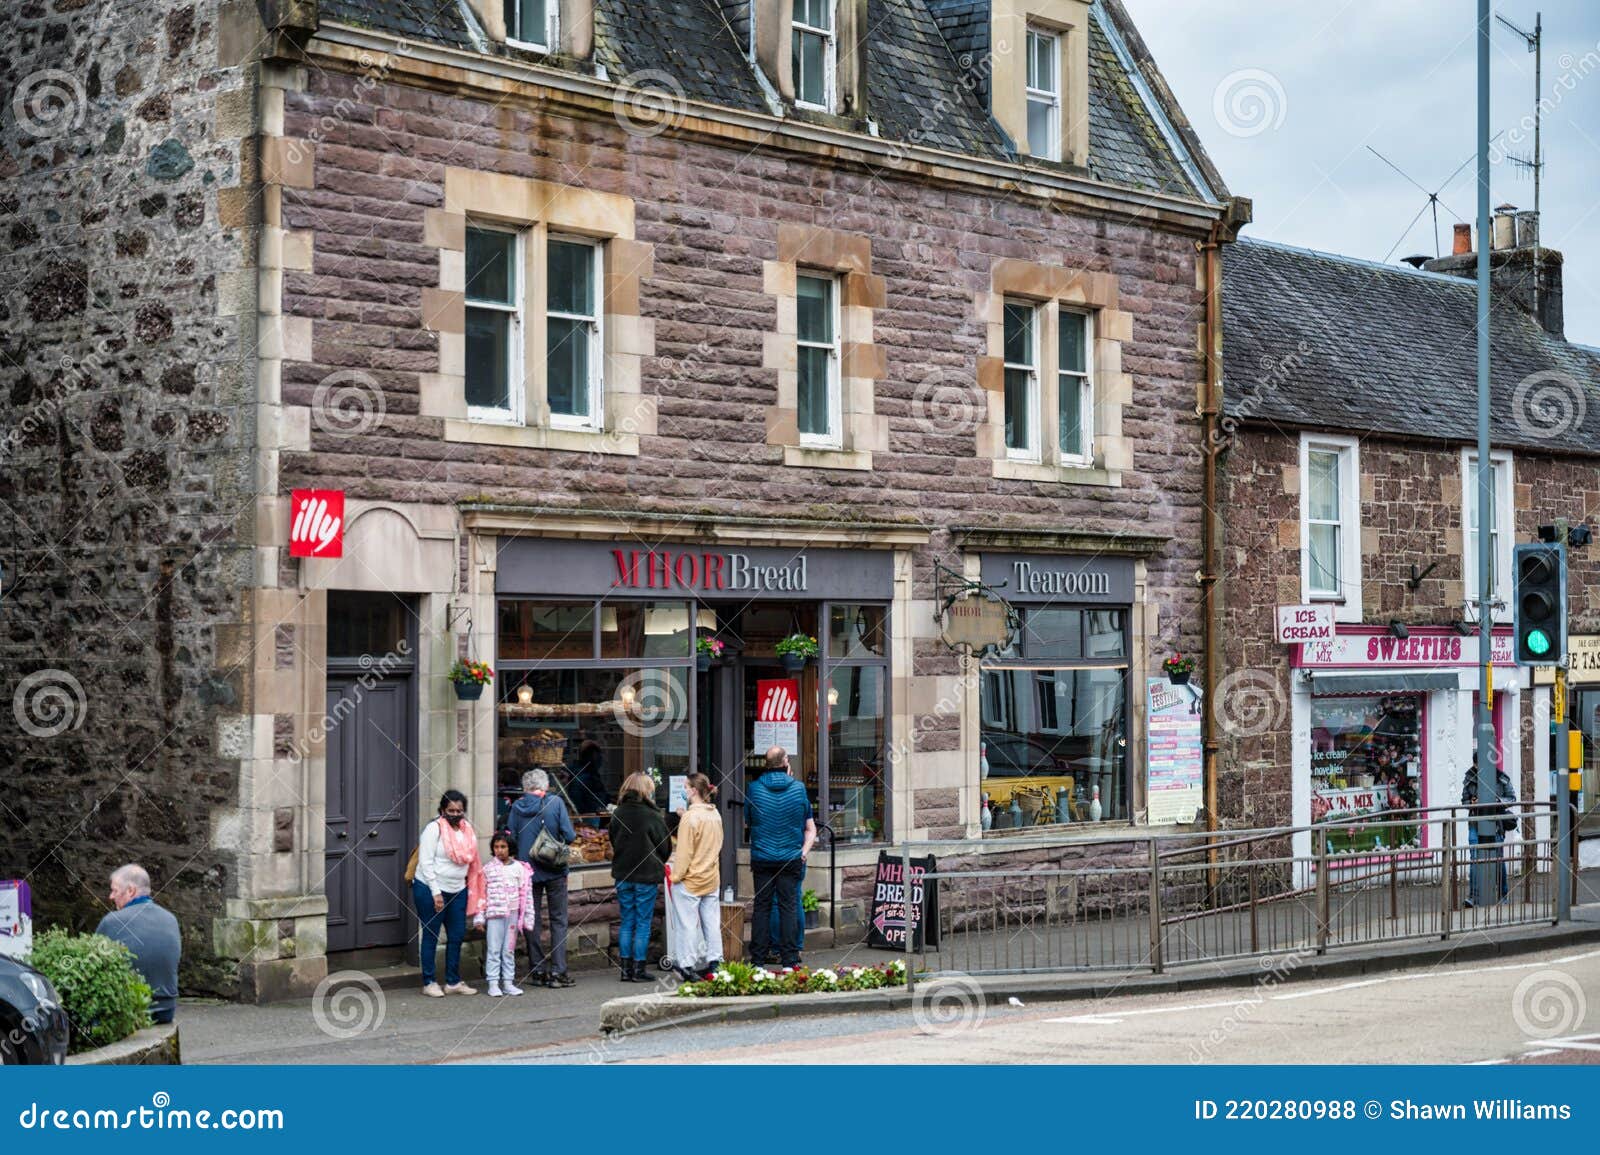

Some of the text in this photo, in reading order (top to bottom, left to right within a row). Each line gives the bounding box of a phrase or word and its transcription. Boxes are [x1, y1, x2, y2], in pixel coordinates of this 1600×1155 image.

[292, 497, 341, 552] illy
[1014, 561, 1110, 594] Tearoom
[1295, 611, 1317, 623] ICE
[1282, 626, 1330, 639] CREAM
[1367, 637, 1461, 661] SWEETIES
[1495, 637, 1506, 648] ICE
[1315, 651, 1332, 662] MIX
[1492, 651, 1512, 662] REAM
[761, 686, 797, 721] illy
[1354, 793, 1374, 809] MIX
[875, 882, 923, 904] BRED
[886, 930, 914, 942] OPE
